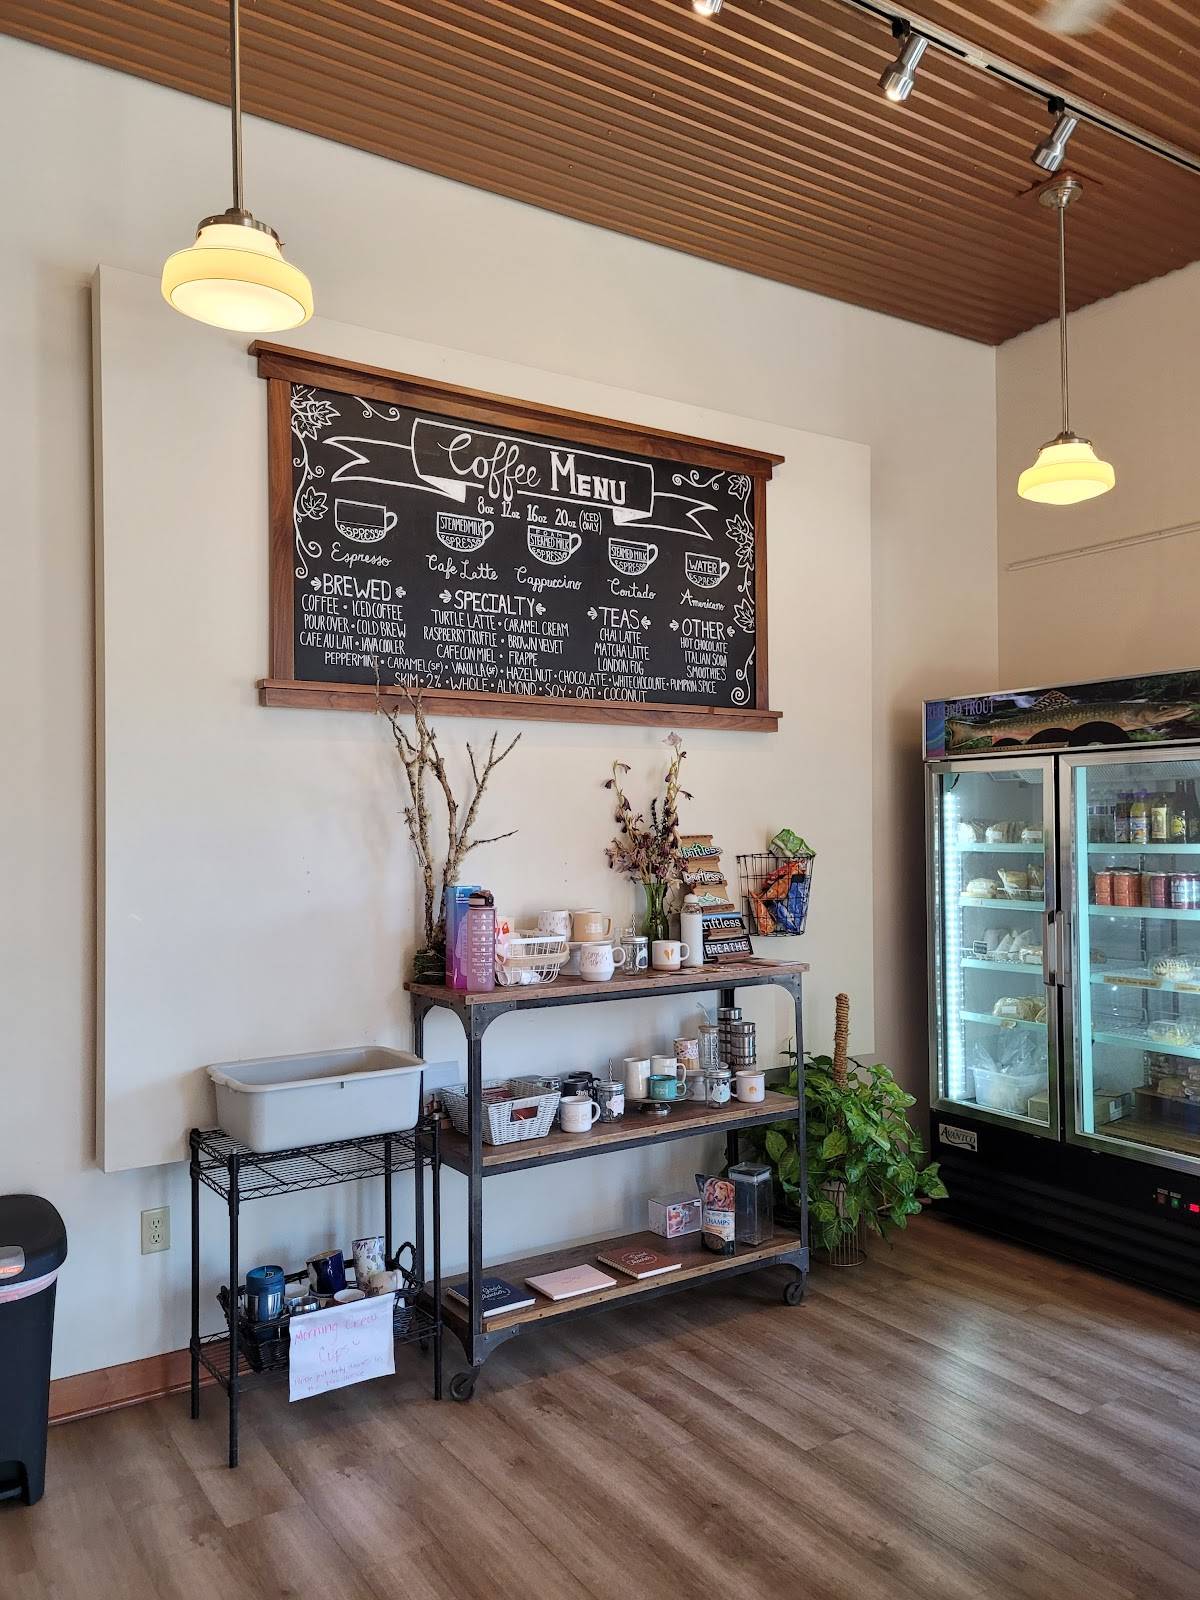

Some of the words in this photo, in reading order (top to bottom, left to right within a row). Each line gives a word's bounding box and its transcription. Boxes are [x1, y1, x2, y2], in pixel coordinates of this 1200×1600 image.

[437, 433, 541, 502] Coffee
[339, 524, 384, 541] ESPRESSO
[441, 534, 483, 550] ESPRESSO
[331, 542, 392, 568] Espresso
[531, 547, 569, 563] ESPRESSO
[426, 555, 458, 580] Cafe
[460, 559, 498, 581] Latte
[614, 561, 646, 573] ESPRESSO
[689, 559, 718, 574] WATER
[323, 573, 392, 602] BREWED
[514, 565, 582, 593] Cappuccino
[607, 578, 657, 600] Cortado
[689, 573, 721, 586] ESPRESSO
[301, 594, 340, 616] COFFEE
[352, 601, 372, 618] ICED
[372, 603, 404, 622] COFFEE
[454, 589, 535, 618] SPECIALTY
[680, 589, 726, 611] Americano
[431, 609, 465, 627] TURTLE
[467, 613, 496, 631] LATTE
[504, 617, 541, 635] CARAMEL
[541, 621, 570, 637] CREAM
[598, 606, 640, 630] TEAS
[356, 619, 379, 637] COLD
[380, 622, 407, 639] BREW
[600, 627, 618, 642] CHAI
[619, 630, 642, 645] LATTE
[681, 618, 727, 641] OTHER
[299, 632, 323, 648] CAFE
[323, 635, 335, 649] AU
[336, 636, 354, 651] LAIT
[423, 626, 466, 643] RASPBERRY
[466, 630, 498, 648] TRUFFLE
[508, 635, 540, 653] BROWN
[538, 638, 564, 654] VELVET
[680, 637, 694, 651] HOT
[694, 639, 729, 655] CHOCOLATE
[436, 644, 460, 659] CAFE
[460, 647, 478, 661] CON
[477, 648, 497, 664] MIEL
[508, 650, 539, 667] FRAPPE
[594, 643, 627, 659] MATCHA
[626, 645, 650, 661] LATTE
[684, 650, 712, 666] ITALIAN
[711, 653, 728, 667] SODA
[597, 657, 629, 673] LONDON
[629, 660, 645, 675] FOG
[686, 665, 727, 681] SMOOTHIES
[450, 676, 489, 692] WHOLE
[497, 679, 537, 696] ALMOND
[545, 685, 567, 699] SOY
[576, 685, 597, 700] OAT
[603, 687, 648, 703] COCONUT
[506, 667, 552, 685] HAZELNUT
[558, 669, 609, 688] CHOCOLATE
[611, 675, 634, 689] WHITE
[634, 677, 667, 692] CHOCOLATE
[670, 679, 698, 693] PUMPKIN
[698, 680, 718, 695] SPICE
[963, 699, 994, 716] TROUT
[702, 917, 742, 930] riftless
[705, 941, 749, 954] BREATHE
[294, 1321, 338, 1344] Morning
